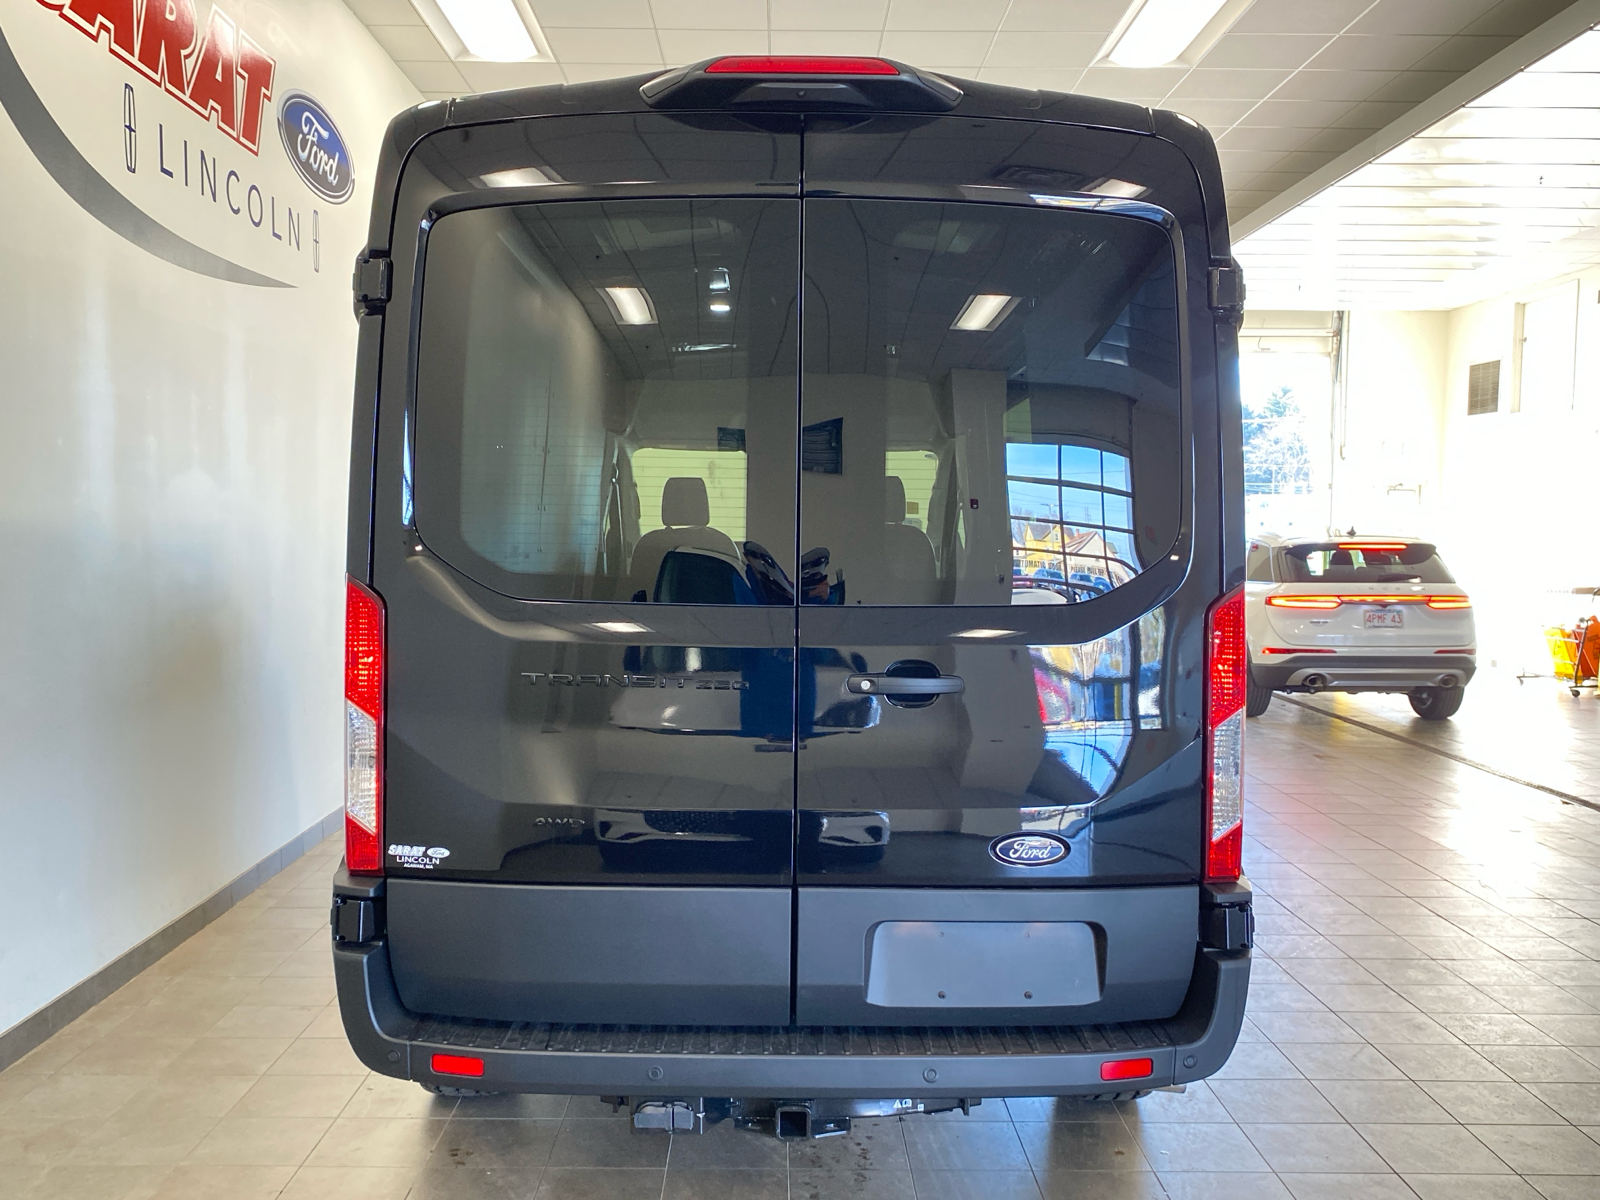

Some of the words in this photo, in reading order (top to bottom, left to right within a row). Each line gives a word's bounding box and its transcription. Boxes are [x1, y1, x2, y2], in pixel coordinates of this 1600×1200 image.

[36, 0, 276, 157] ARAT
[297, 111, 339, 186] Ford
[158, 123, 300, 252] LINCOLN
[1366, 614, 1387, 623] 4PMF
[521, 672, 693, 689] TRANSIT
[532, 817, 586, 828] AWD
[388, 844, 426, 856] SARAT
[1009, 840, 1051, 859] Ford
[396, 855, 440, 865] LINCOLN
